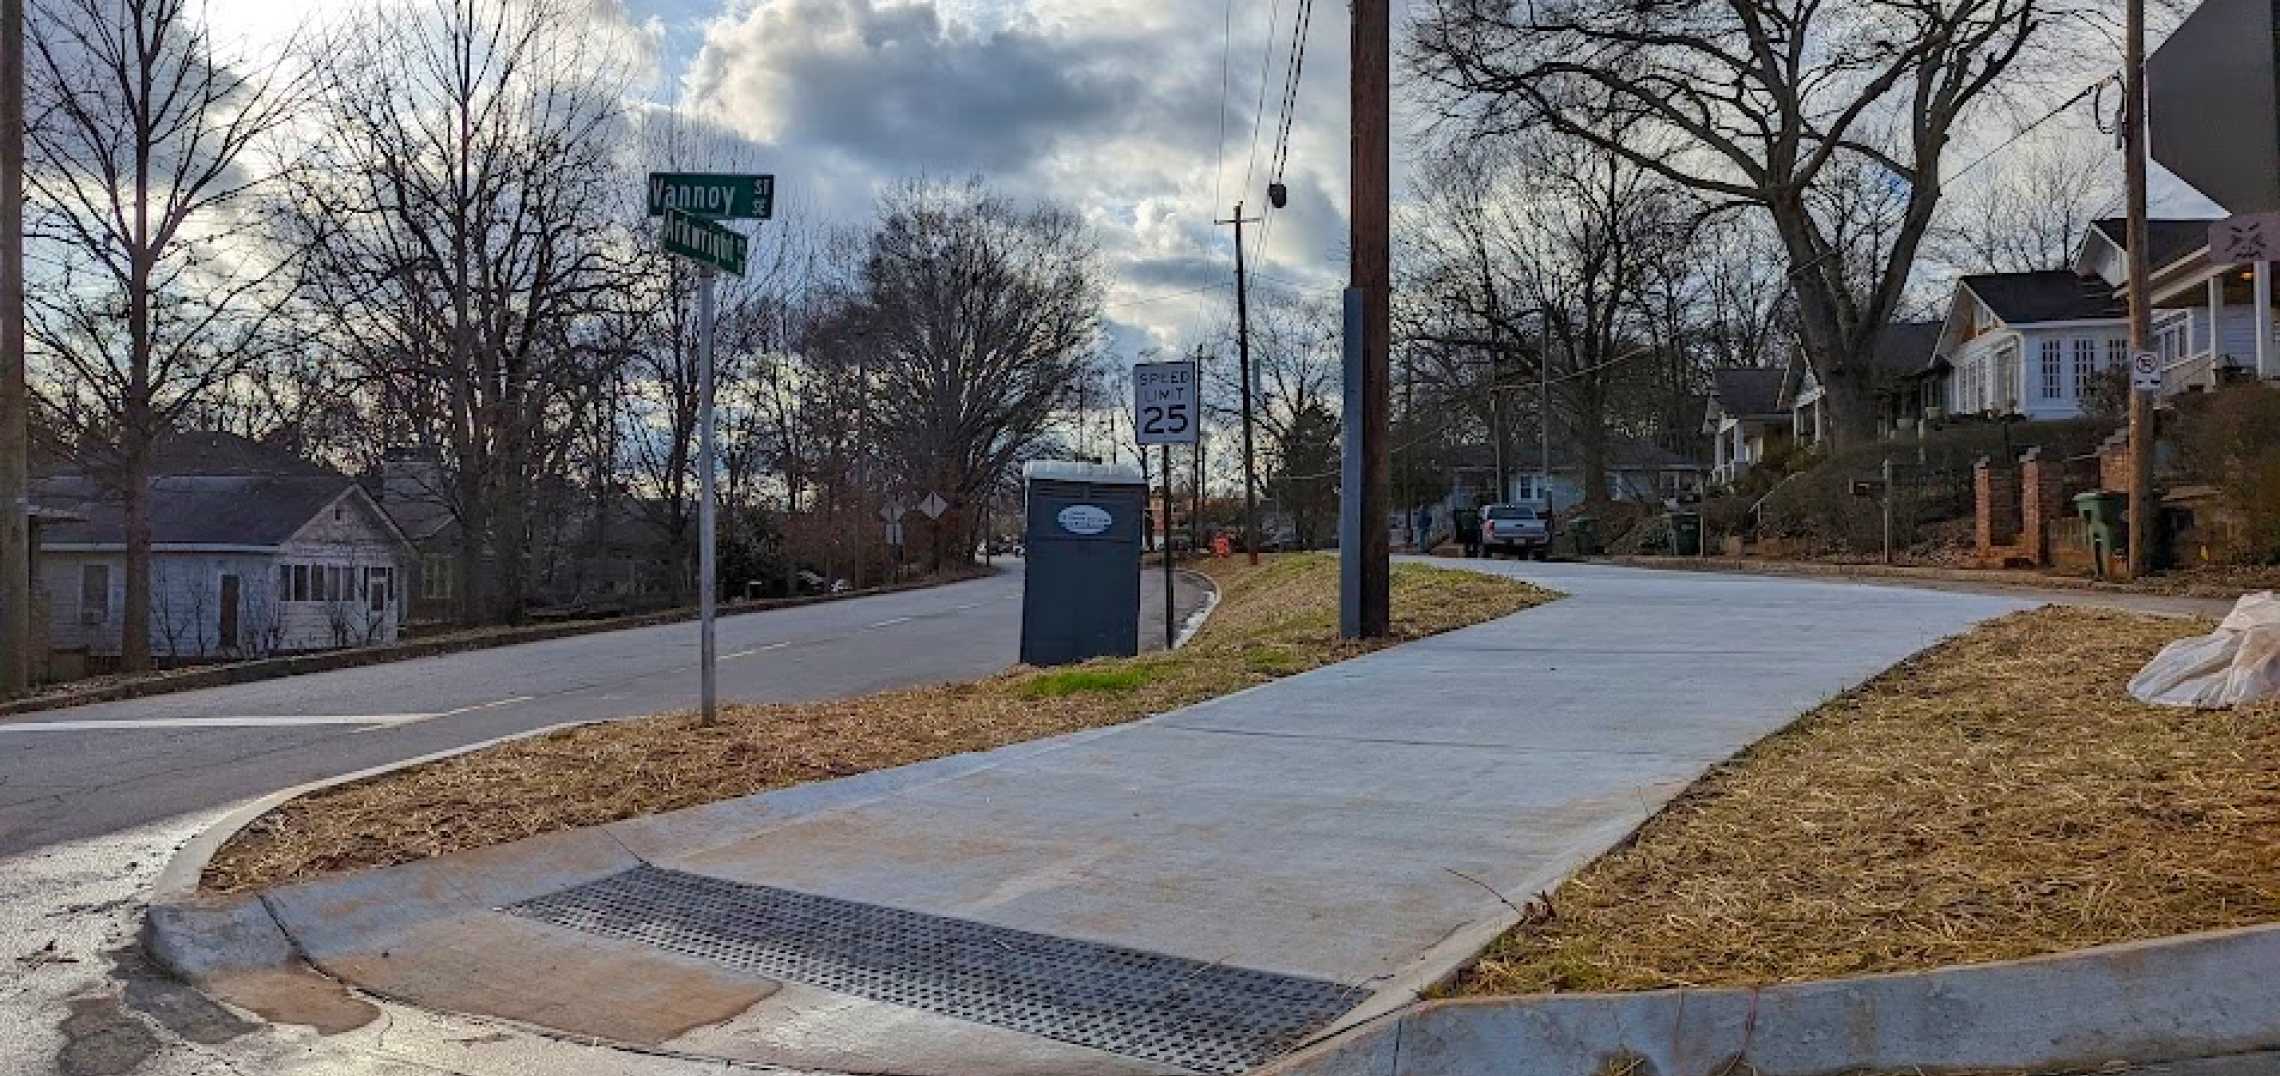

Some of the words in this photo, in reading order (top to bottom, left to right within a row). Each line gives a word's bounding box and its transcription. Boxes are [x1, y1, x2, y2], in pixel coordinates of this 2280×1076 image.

[654, 178, 735, 216] Vannoy
[1140, 371, 1190, 386] SPEED
[1145, 387, 1184, 402] LIMIT
[1143, 404, 1189, 434] 25
